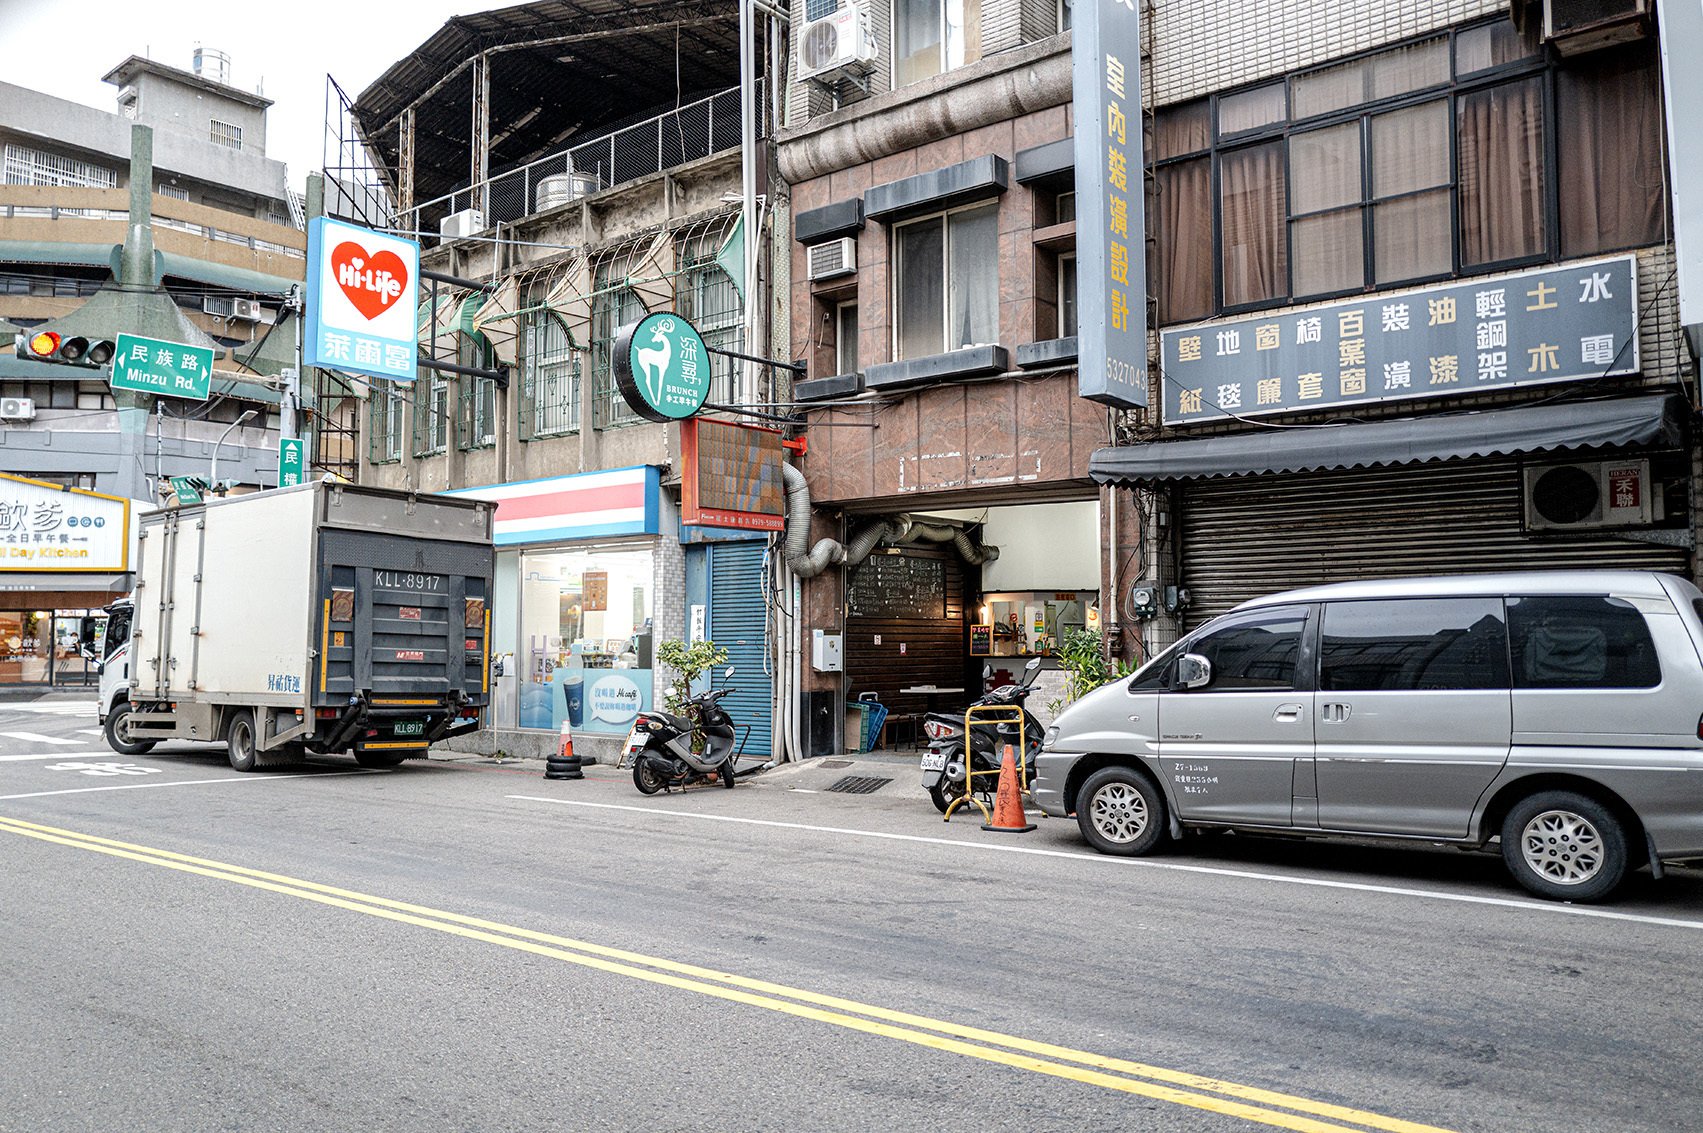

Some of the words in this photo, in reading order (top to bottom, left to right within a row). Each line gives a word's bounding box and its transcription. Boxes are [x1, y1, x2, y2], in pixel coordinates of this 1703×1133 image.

[1106, 52, 1129, 333] 室內裝潢設計
[130, 343, 199, 372] 民族路
[324, 332, 411, 371] 萊爾富
[1297, 317, 1323, 400] 椅套
[1338, 309, 1367, 397] 百葉窗
[1381, 304, 1411, 389] 裝潢
[1428, 298, 1458, 385] 油漆
[1475, 287, 1507, 379] 輕鋼架
[1526, 281, 1560, 373] 土木
[1579, 271, 1614, 366] 水電
[126, 367, 167, 387] Minzu
[174, 374, 196, 391] Rd.
[666, 384, 698, 398] BRUNCH
[1107, 356, 1146, 390] 5327043
[1178, 335, 1202, 413] 壁紙
[1216, 329, 1242, 410] 地毯
[1255, 323, 1283, 405] 窗簾
[1616, 478, 1634, 507] 禾聯
[6, 533, 69, 544] 全日早午餐
[10, 547, 35, 560] Day
[40, 547, 88, 558] Kitchen
